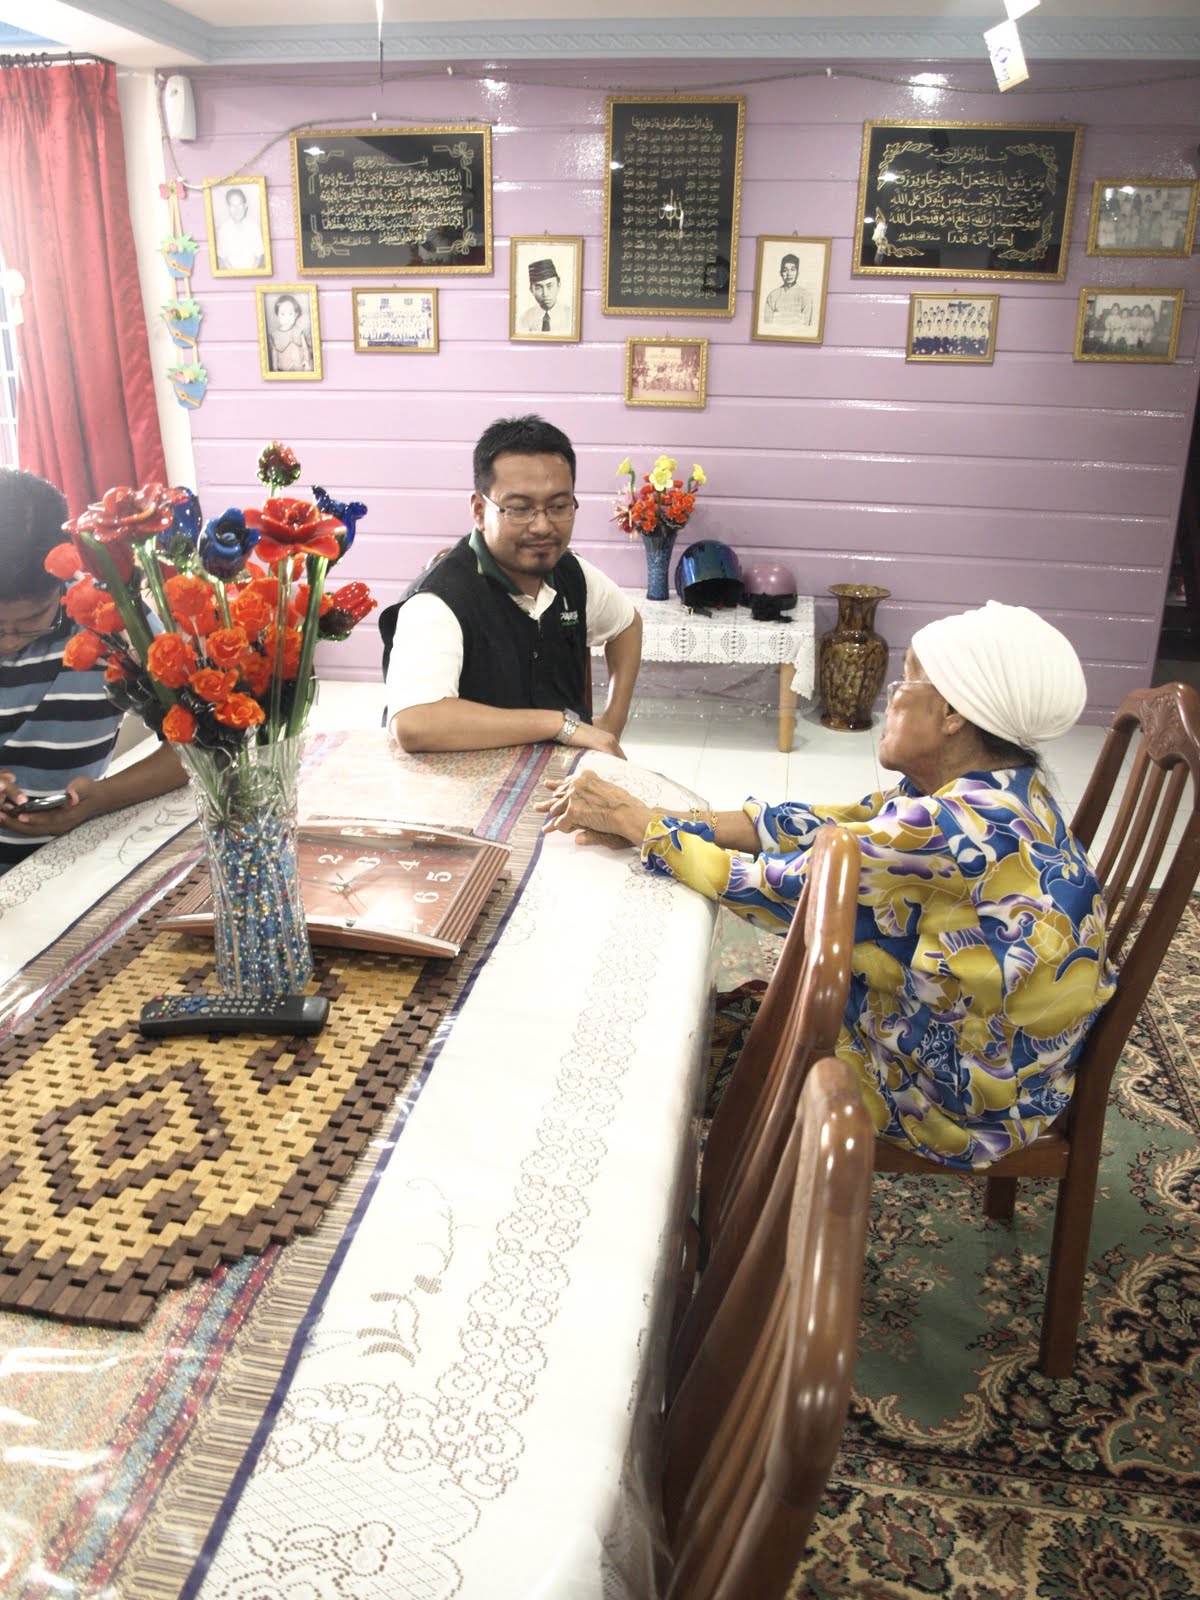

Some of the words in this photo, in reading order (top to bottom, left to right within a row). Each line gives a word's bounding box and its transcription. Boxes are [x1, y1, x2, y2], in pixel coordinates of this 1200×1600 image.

[318, 855, 344, 865] 2
[397, 859, 421, 872] 4
[426, 871, 453, 883] 5
[413, 892, 440, 904] 6
